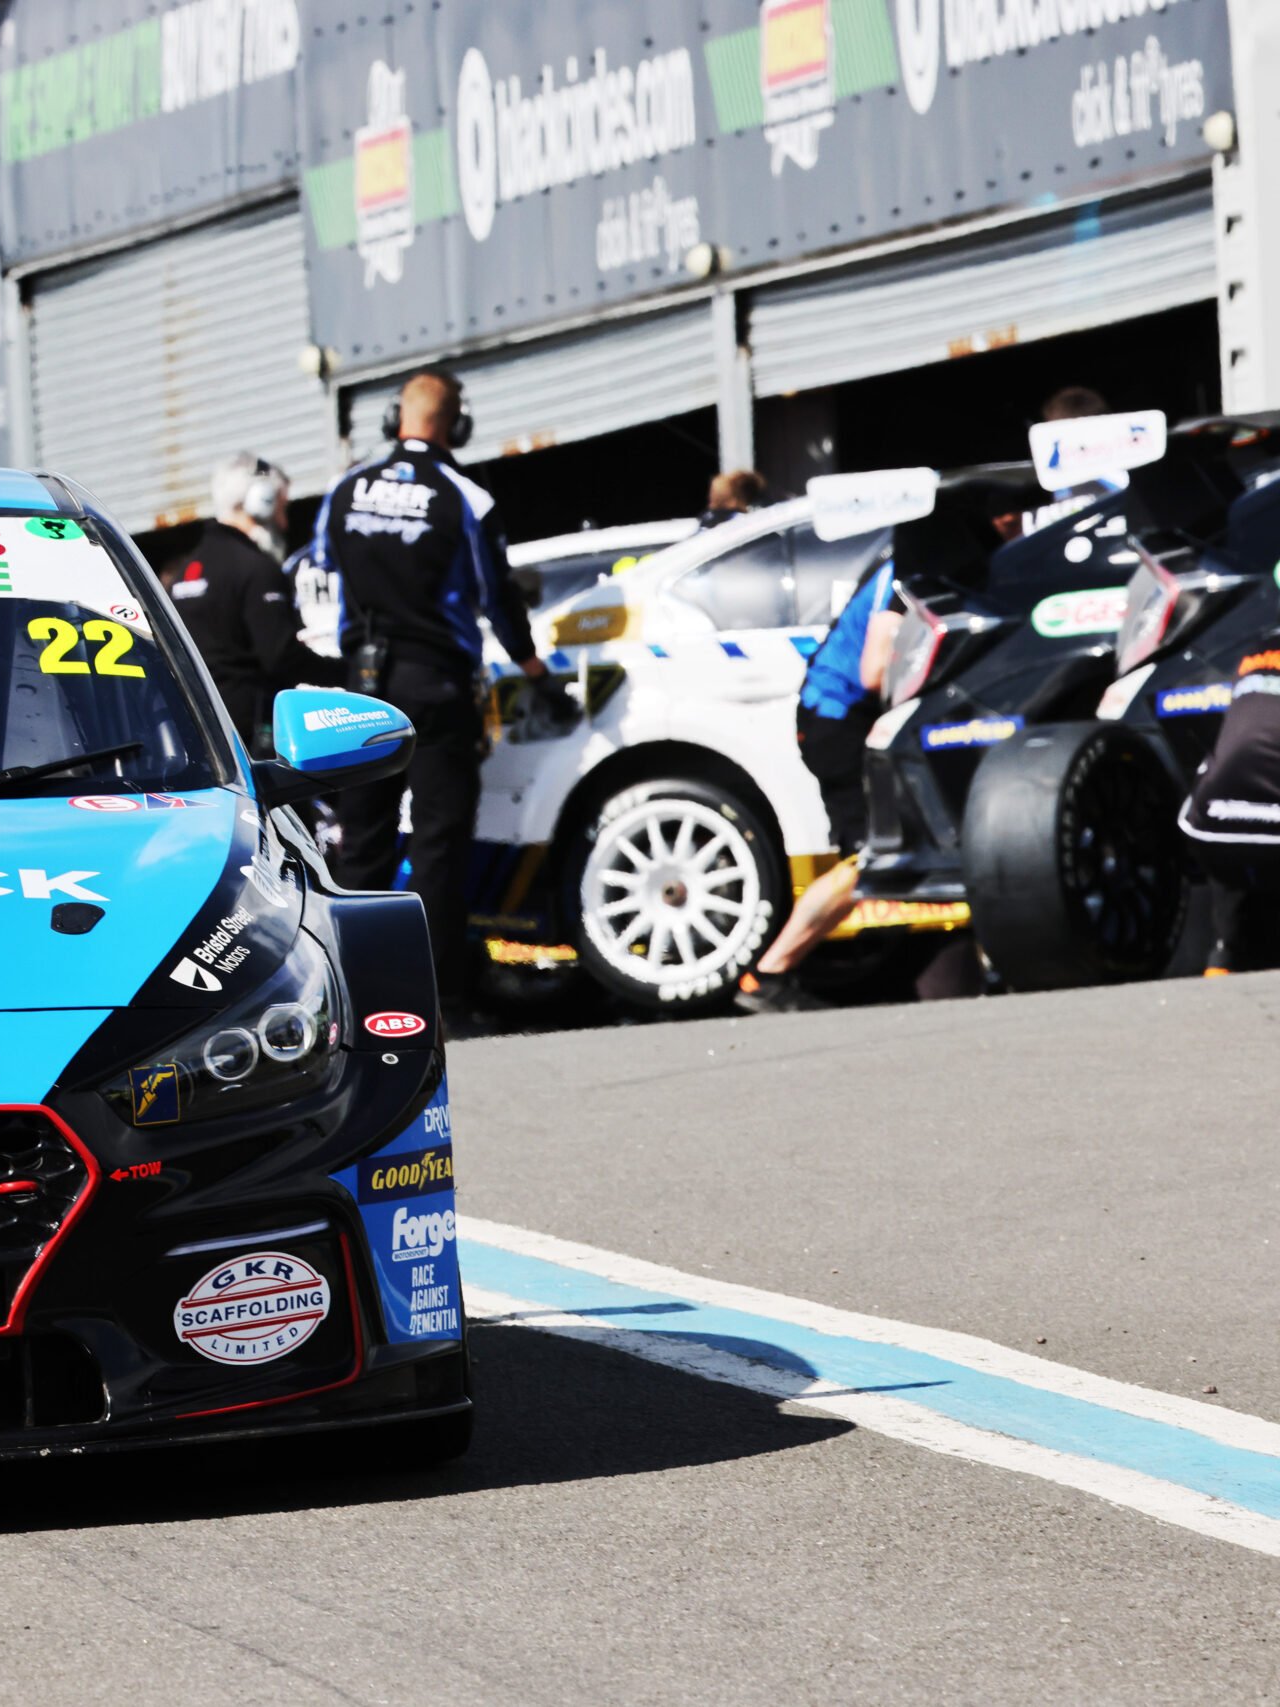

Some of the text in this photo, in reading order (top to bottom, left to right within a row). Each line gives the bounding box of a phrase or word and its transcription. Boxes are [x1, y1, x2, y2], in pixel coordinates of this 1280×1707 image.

[27, 617, 146, 678] 22
[193, 906, 256, 966] Bristol Street
[214, 945, 252, 974] Motors
[375, 1017, 417, 1031] ABS
[129, 1160, 162, 1179] TOW
[211, 1260, 295, 1290] GKR
[411, 1264, 435, 1288] RACE
[181, 1290, 324, 1327] SCAFFOLDING
[410, 1285, 449, 1312] AGAINST
[410, 1307, 458, 1336] DEMENTIA
[210, 1325, 299, 1355] LIMITED
